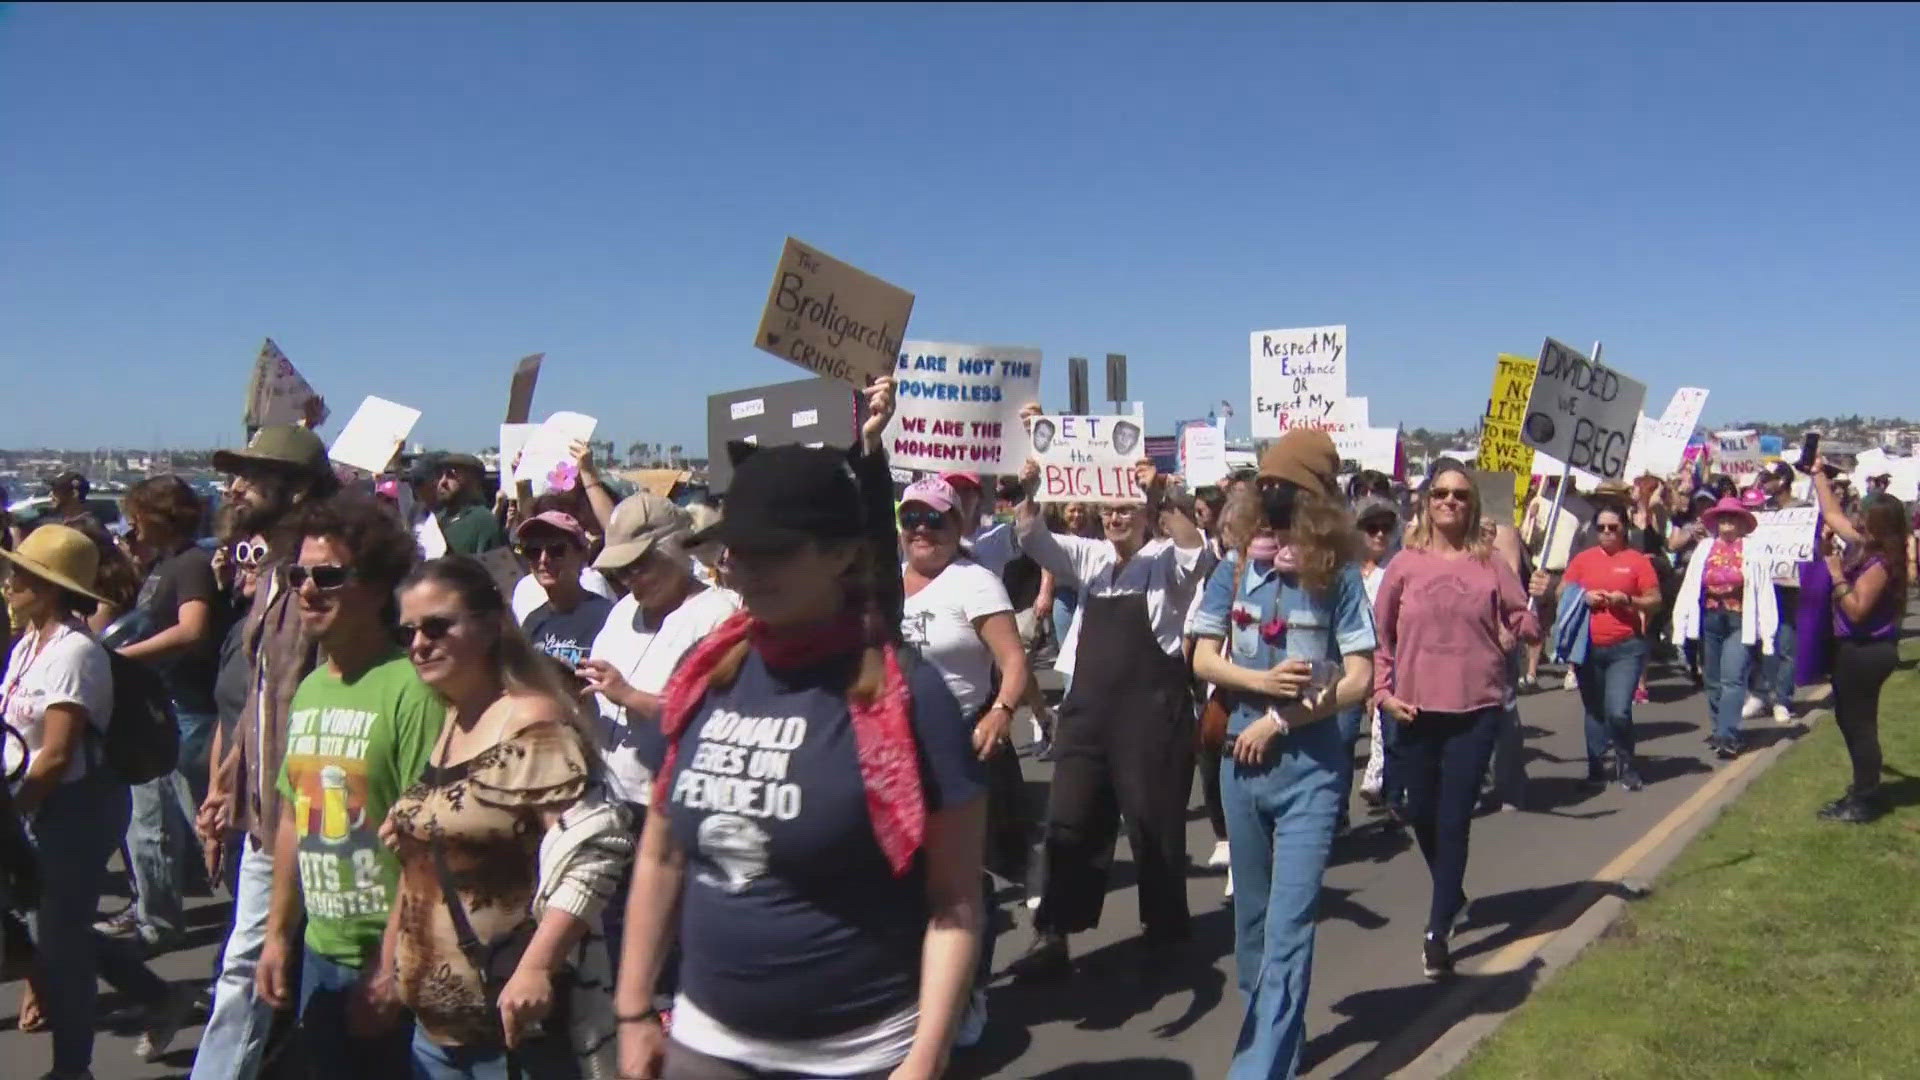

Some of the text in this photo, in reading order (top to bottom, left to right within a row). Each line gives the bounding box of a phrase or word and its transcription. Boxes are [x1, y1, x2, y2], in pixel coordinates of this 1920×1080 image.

[776, 272, 899, 356] Broligarchy
[1263, 333, 1343, 362] Respect My
[790, 339, 855, 382] CRINGE
[899, 354, 1032, 378] E ARE NOT THE
[1540, 343, 1619, 402] DIVIDED
[899, 380, 1003, 402] POWERLESS
[1293, 377, 1308, 394] OR
[1257, 394, 1334, 418] Expect My
[1557, 394, 1579, 416] WE
[902, 416, 1003, 438] WE ARE THE
[1063, 417, 1100, 438] E T
[894, 439, 1002, 462] MOMENTUM!
[1070, 449, 1094, 462] the
[1495, 442, 1518, 459] WE
[1046, 465, 1141, 498] BIG LIE
[748, 750, 790, 780] UN
[671, 769, 802, 821] PENDEJO
[352, 849, 382, 888] &
